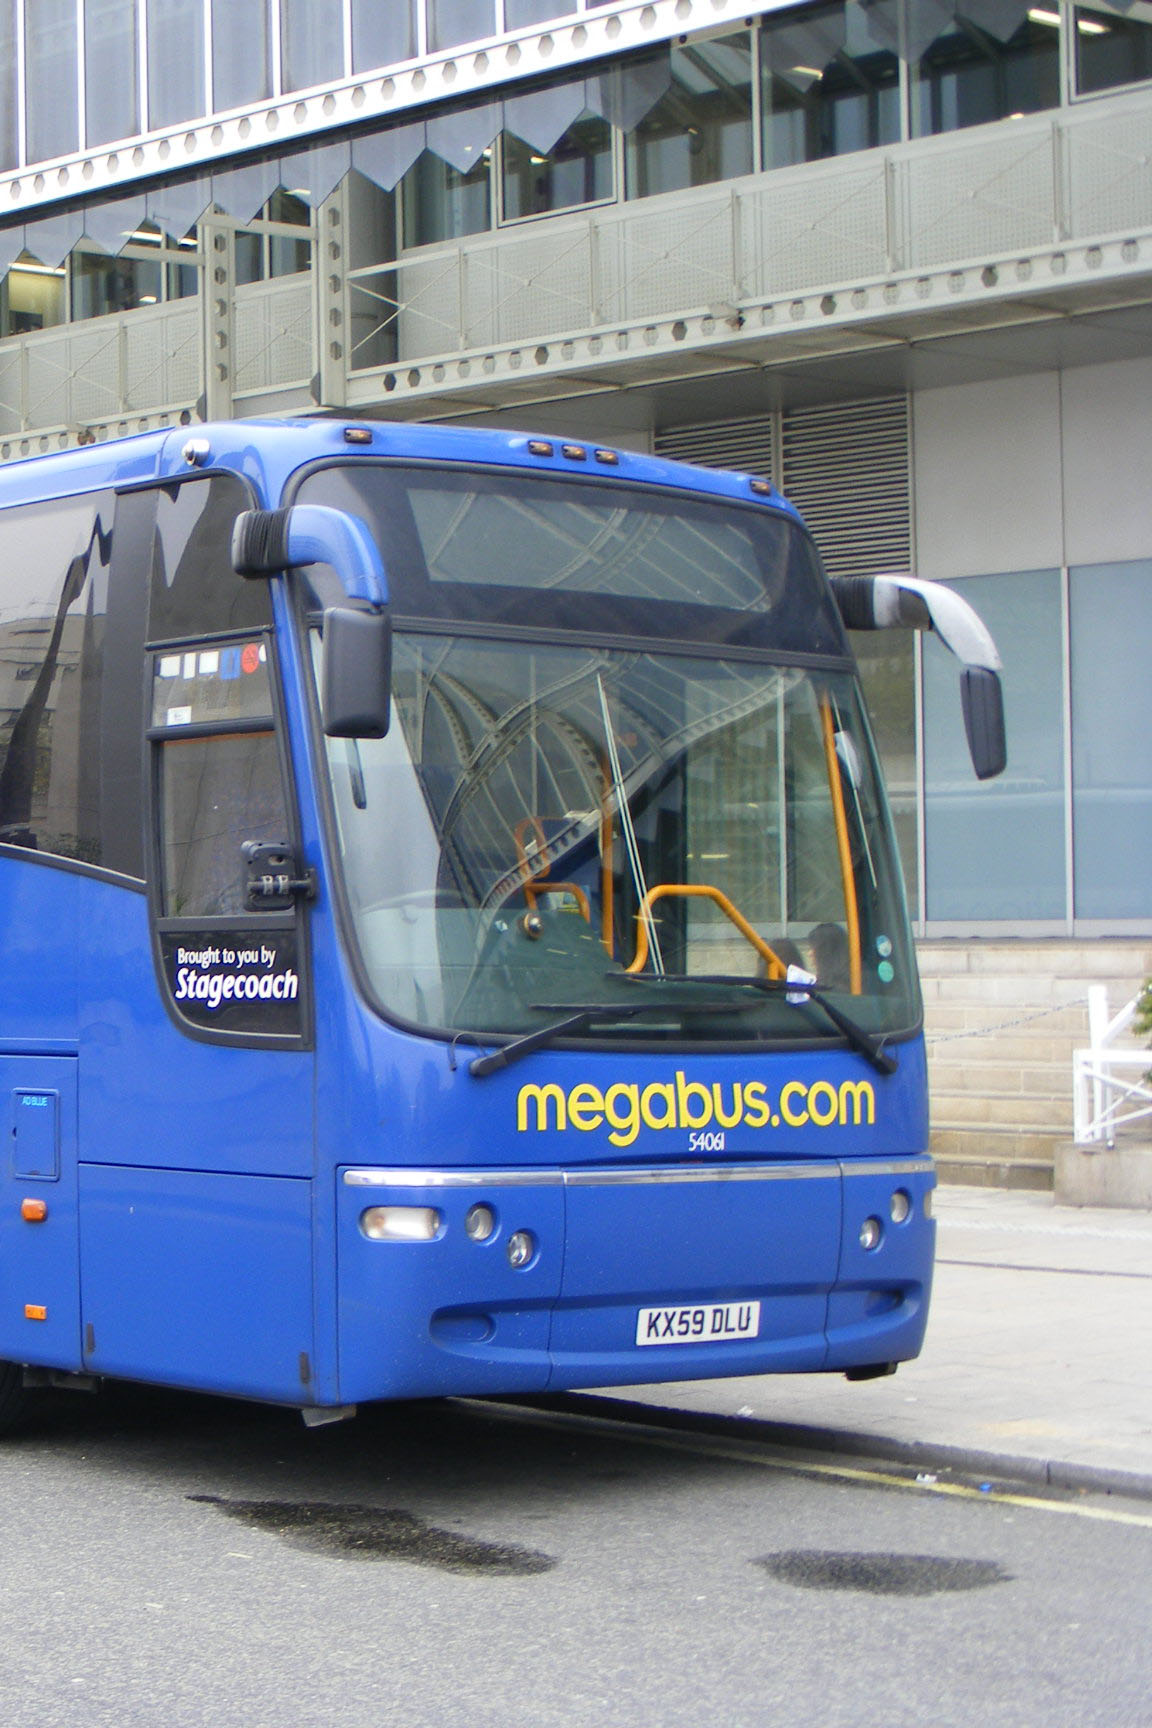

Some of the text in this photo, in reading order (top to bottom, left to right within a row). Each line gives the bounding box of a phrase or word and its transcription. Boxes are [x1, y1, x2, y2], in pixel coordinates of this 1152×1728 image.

[177, 945, 277, 969] Brought to you by
[175, 968, 298, 1008] Stagecoach
[517, 1071, 875, 1147] megabus.com
[688, 1132, 725, 1152] 54061
[646, 1305, 750, 1338] KX59 DLU
